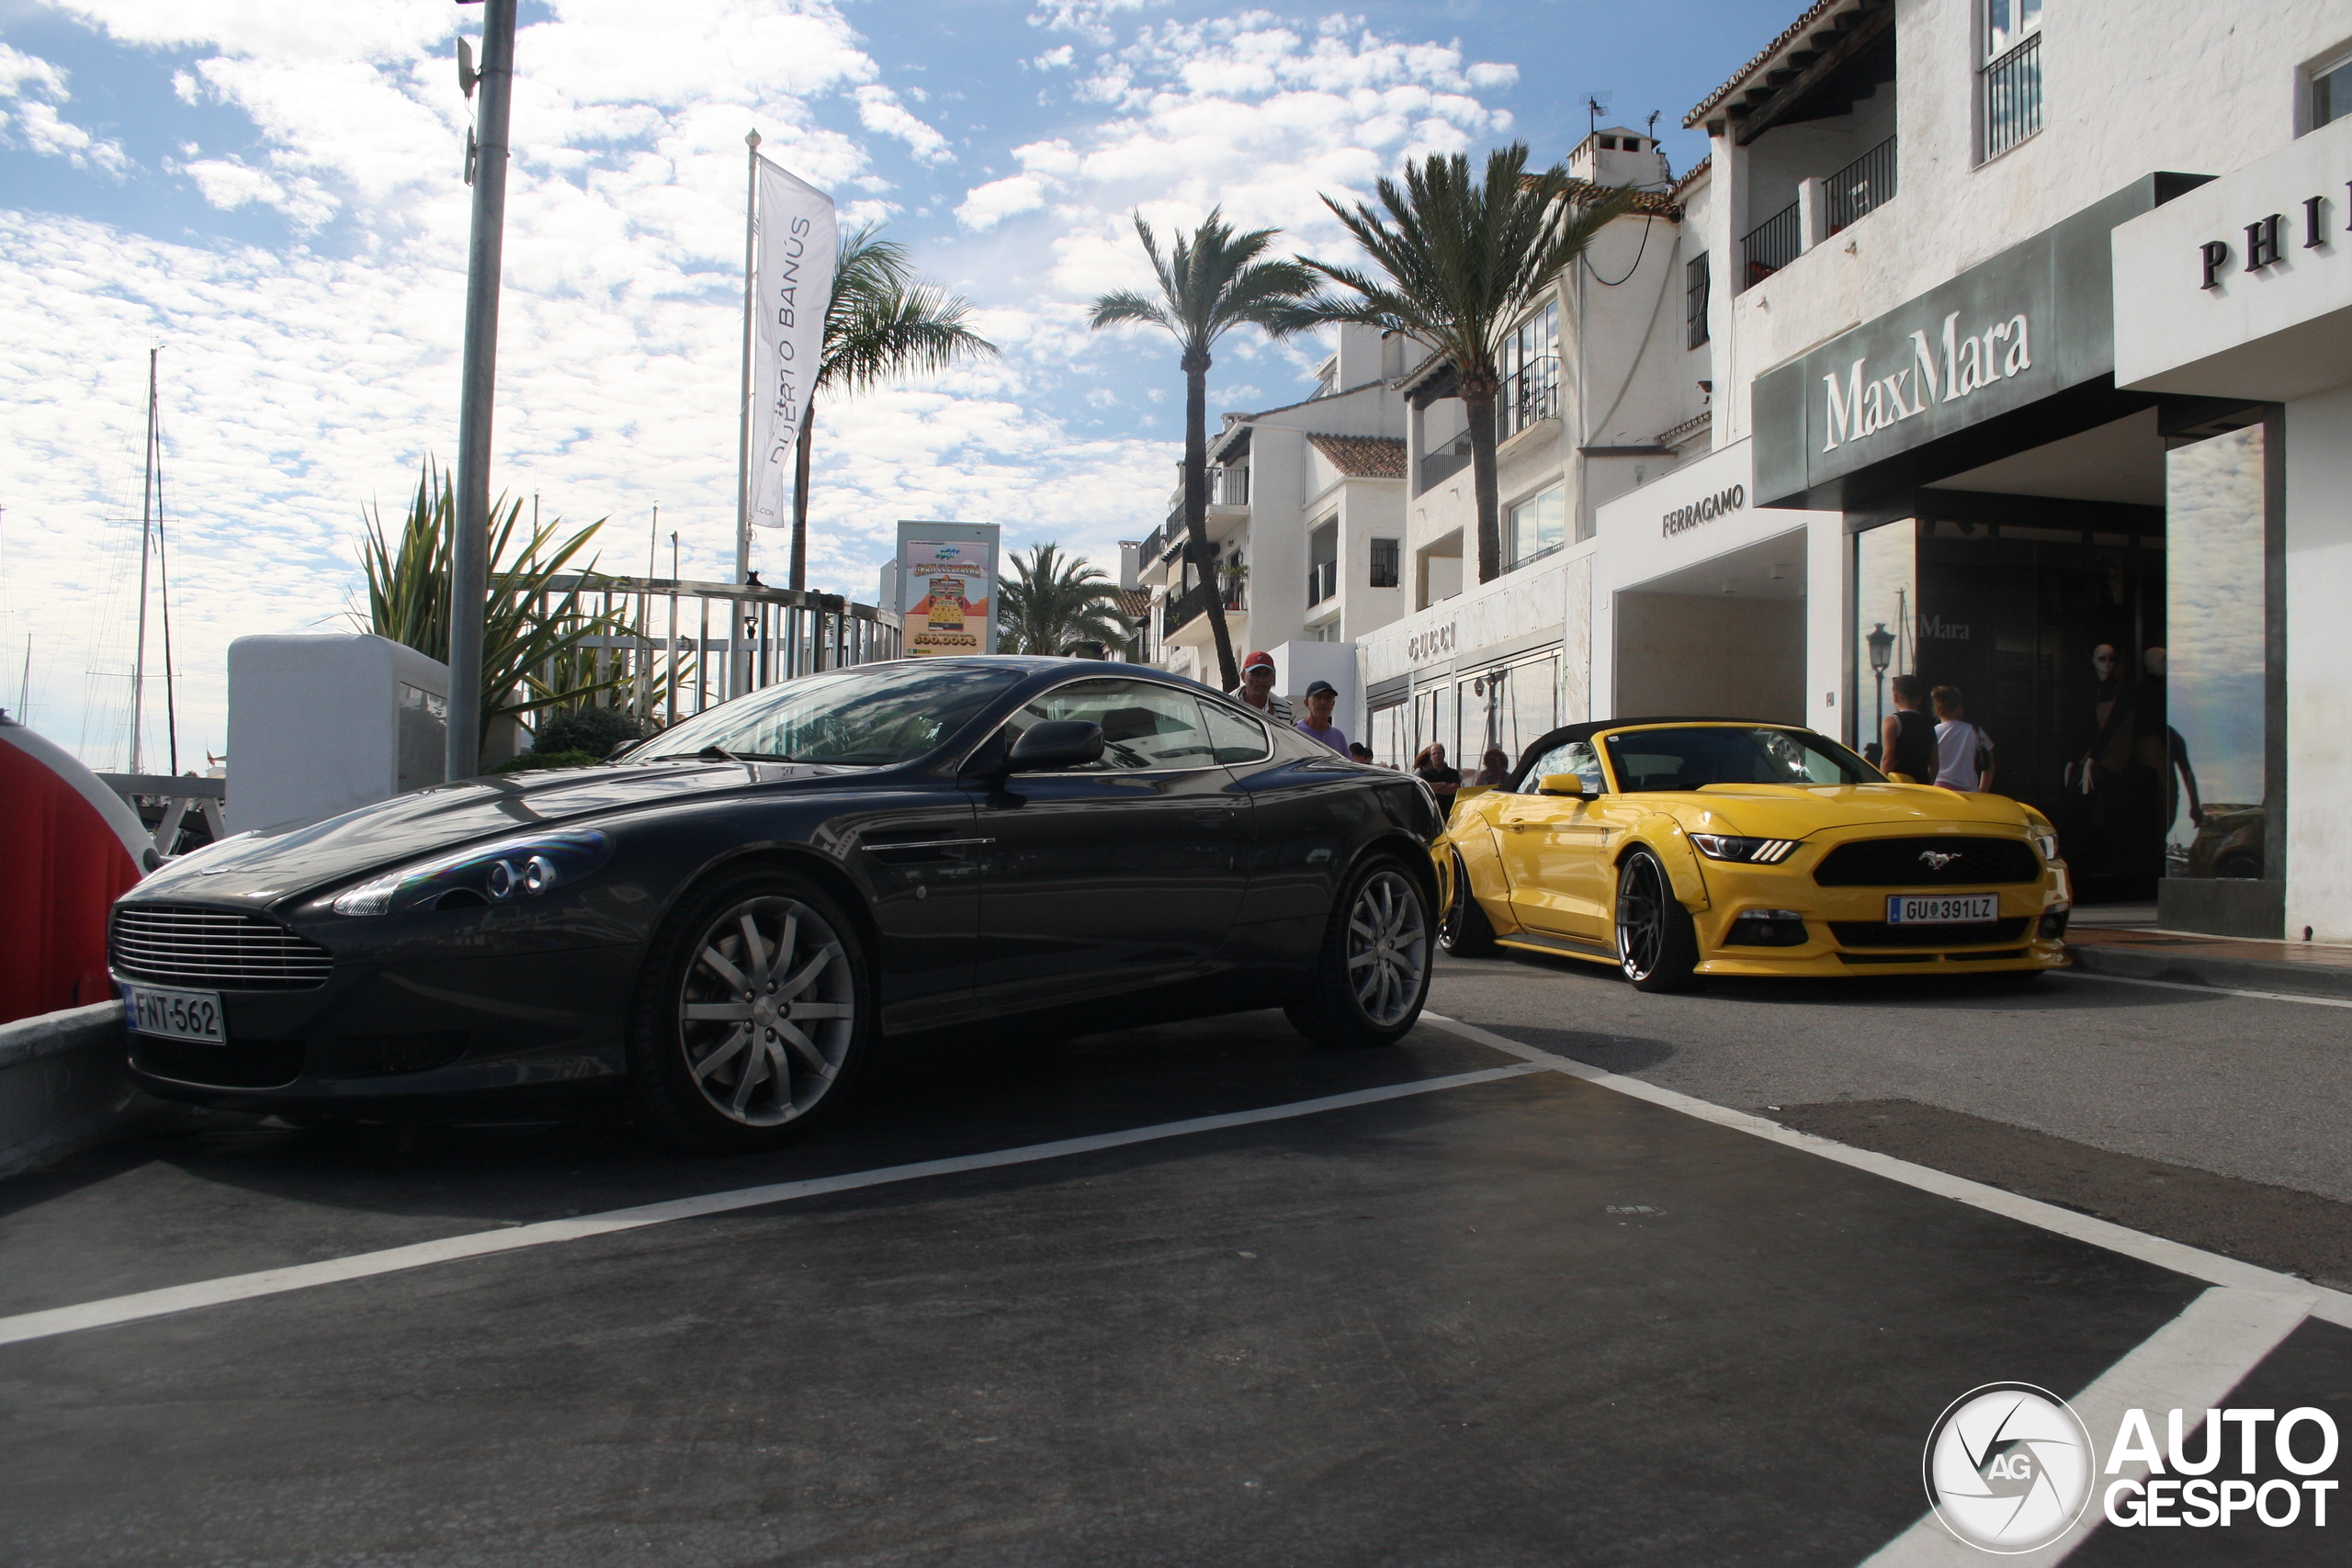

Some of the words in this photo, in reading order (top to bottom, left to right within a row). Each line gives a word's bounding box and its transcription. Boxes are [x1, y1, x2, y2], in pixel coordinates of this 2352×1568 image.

[2199, 180, 2352, 290] PHI
[778, 216, 810, 329] BANÚS
[1662, 484, 1744, 538] FERRAGAMO
[913, 562, 936, 577] GRAN
[937, 563, 981, 579] CLEOPATRA
[1408, 620, 1455, 660] GUCCI
[1917, 613, 1971, 640] Mara
[134, 991, 219, 1036] FNT-562
